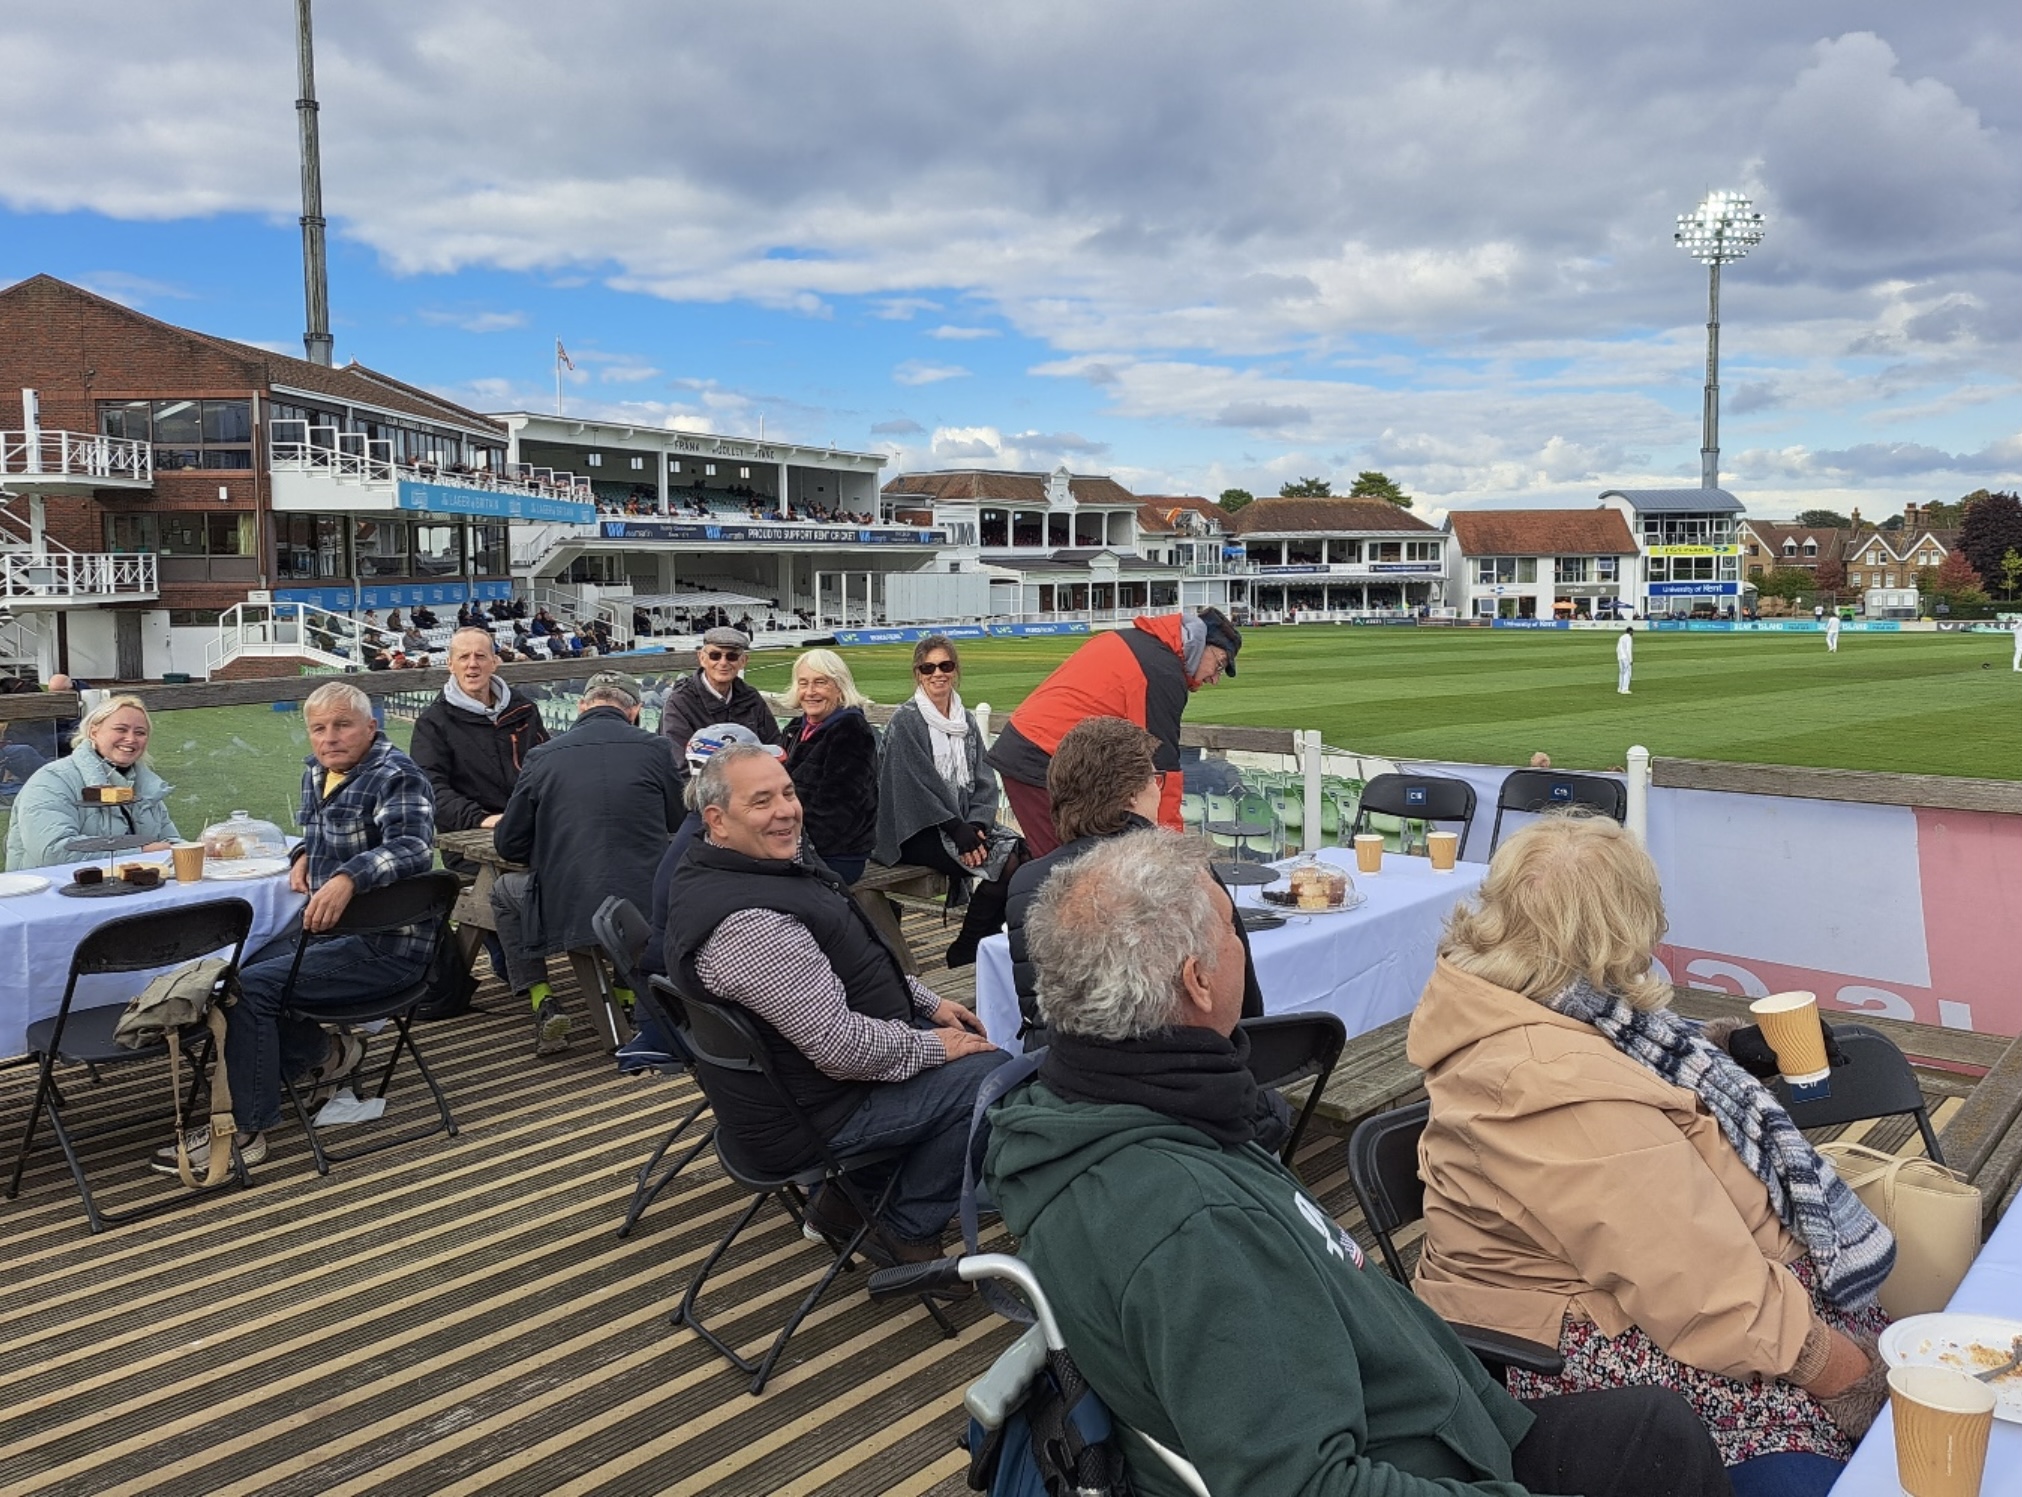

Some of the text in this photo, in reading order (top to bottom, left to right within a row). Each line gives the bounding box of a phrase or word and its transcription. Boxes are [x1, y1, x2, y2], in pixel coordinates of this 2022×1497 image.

[674, 440, 700, 451] FRANK
[748, 528, 856, 541] PROUD TO SUPPORT KENT CRICKET
[1662, 586, 1693, 594] University
[1703, 584, 1723, 592] Kent
[1503, 620, 1531, 628] University
[1759, 622, 1784, 630] ISLAND
